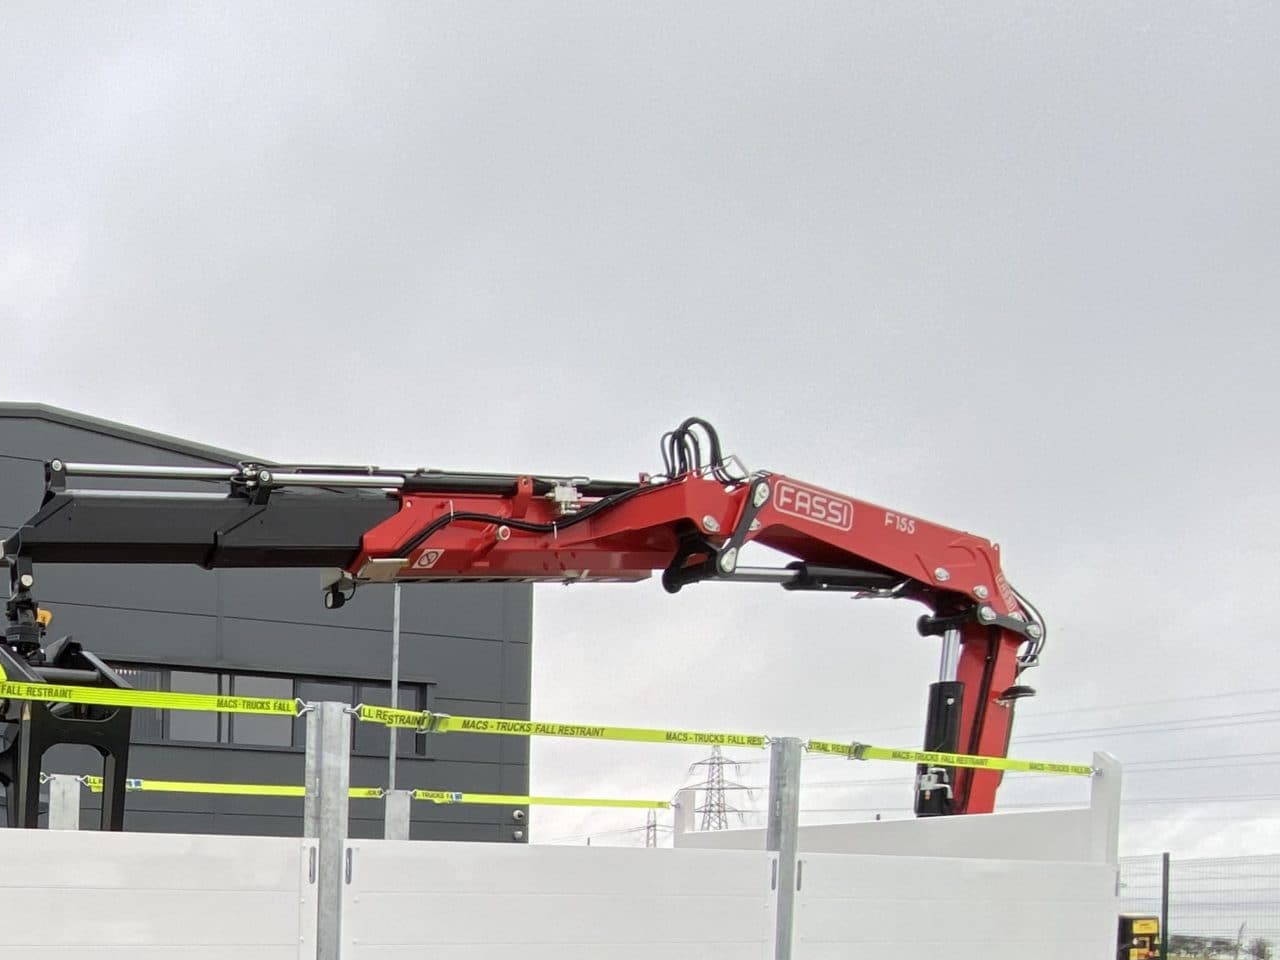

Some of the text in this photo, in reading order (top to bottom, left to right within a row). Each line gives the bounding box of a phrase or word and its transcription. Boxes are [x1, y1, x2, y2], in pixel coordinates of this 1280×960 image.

[779, 486, 849, 527] FASSI
[1, 685, 21, 696] FALL
[27, 687, 72, 698] RESTRAINT
[273, 702, 291, 711] FALL
[461, 719, 489, 730] MACS
[496, 721, 532, 732] TRUCKS
[535, 724, 556, 734] FALL
[558, 727, 606, 737] RESTRAINT
[666, 731, 688, 741] MACS
[694, 733, 724, 744] TRUCKS
[727, 735, 745, 744] FALL
